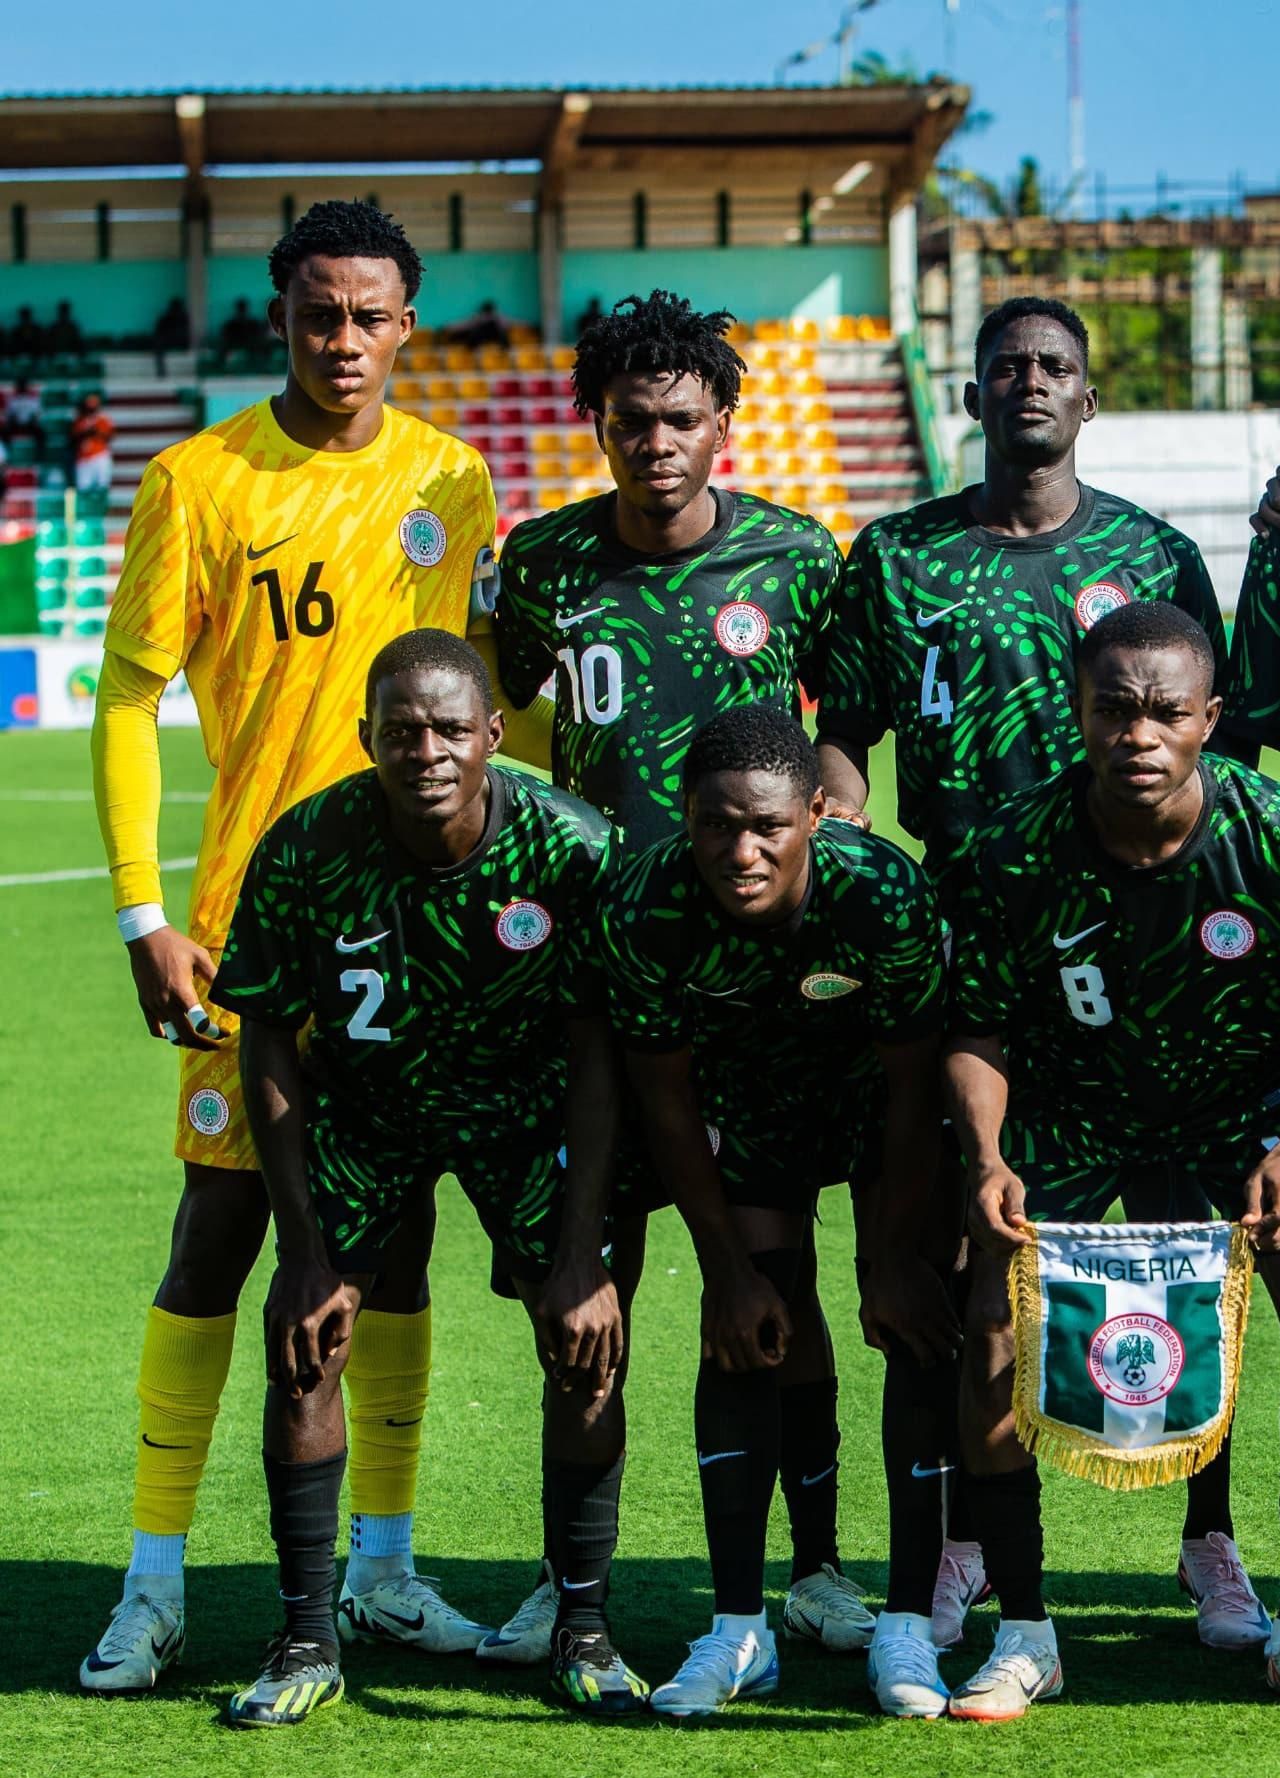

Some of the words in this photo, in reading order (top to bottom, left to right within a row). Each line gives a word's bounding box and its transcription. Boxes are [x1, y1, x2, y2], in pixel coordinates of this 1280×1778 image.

[251, 561, 334, 642] 16
[557, 644, 622, 725] 10
[921, 646, 954, 725] 4
[340, 969, 391, 1041] 2
[1060, 964, 1113, 1026] 8
[1073, 1257, 1197, 1282] NIGERIA
[1090, 1338, 1105, 1377] NIGERIA
[1103, 1318, 1151, 1341] FOOTBALL
[1153, 1320, 1184, 1378] FEDERATION
[1124, 1393, 1148, 1402] 1945
